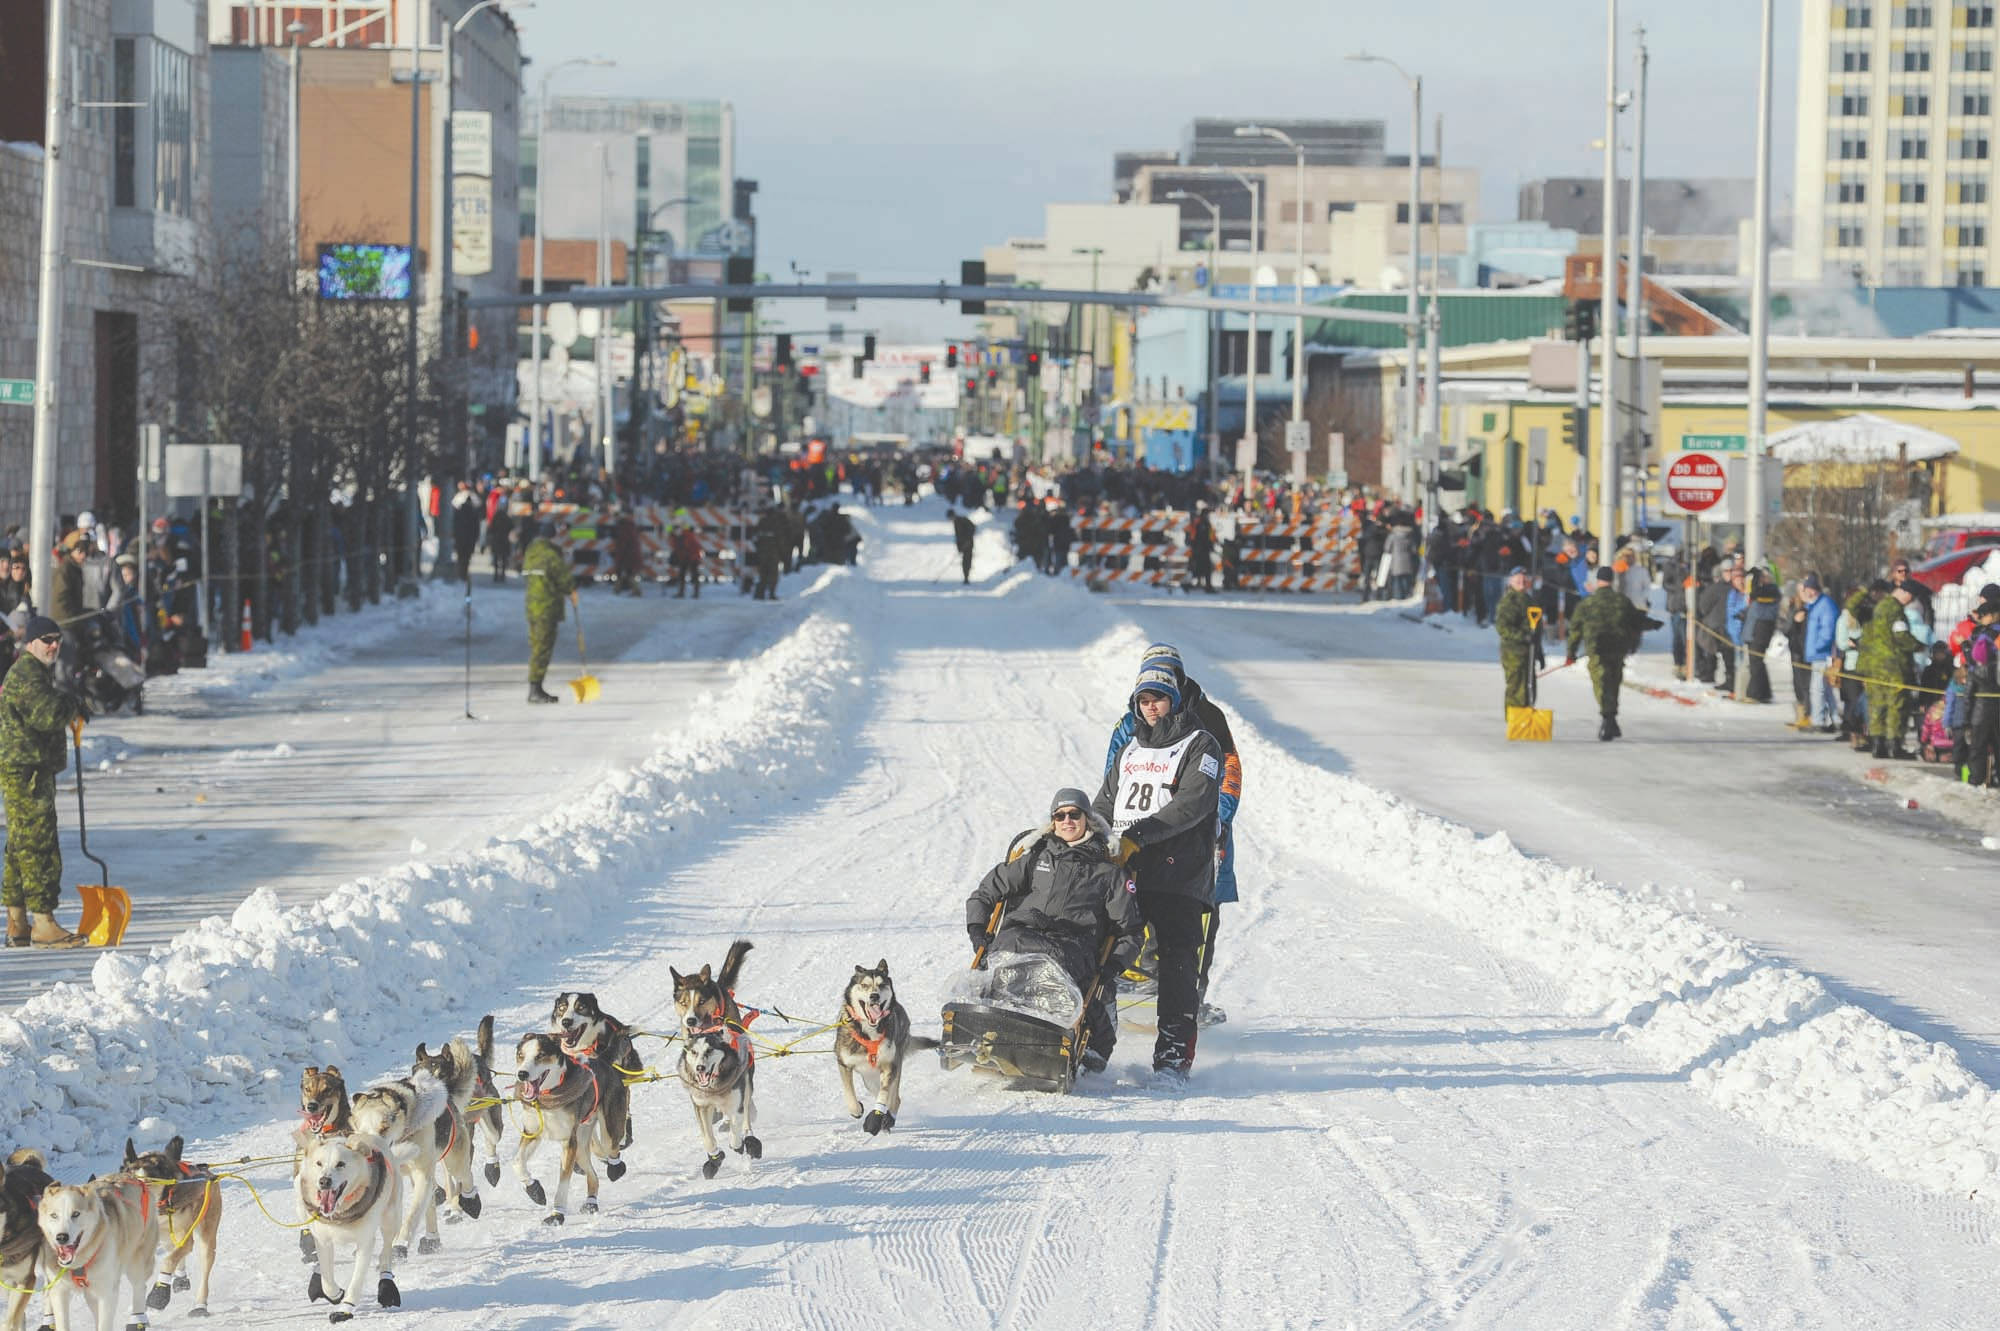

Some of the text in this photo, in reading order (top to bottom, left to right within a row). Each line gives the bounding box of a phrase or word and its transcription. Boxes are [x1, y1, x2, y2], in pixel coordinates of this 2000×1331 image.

[1687, 437, 1723, 449] Barrow
[1674, 464, 1718, 474] DO NOT
[1678, 491, 1714, 502] ENTER
[1125, 782, 1153, 811] 28
